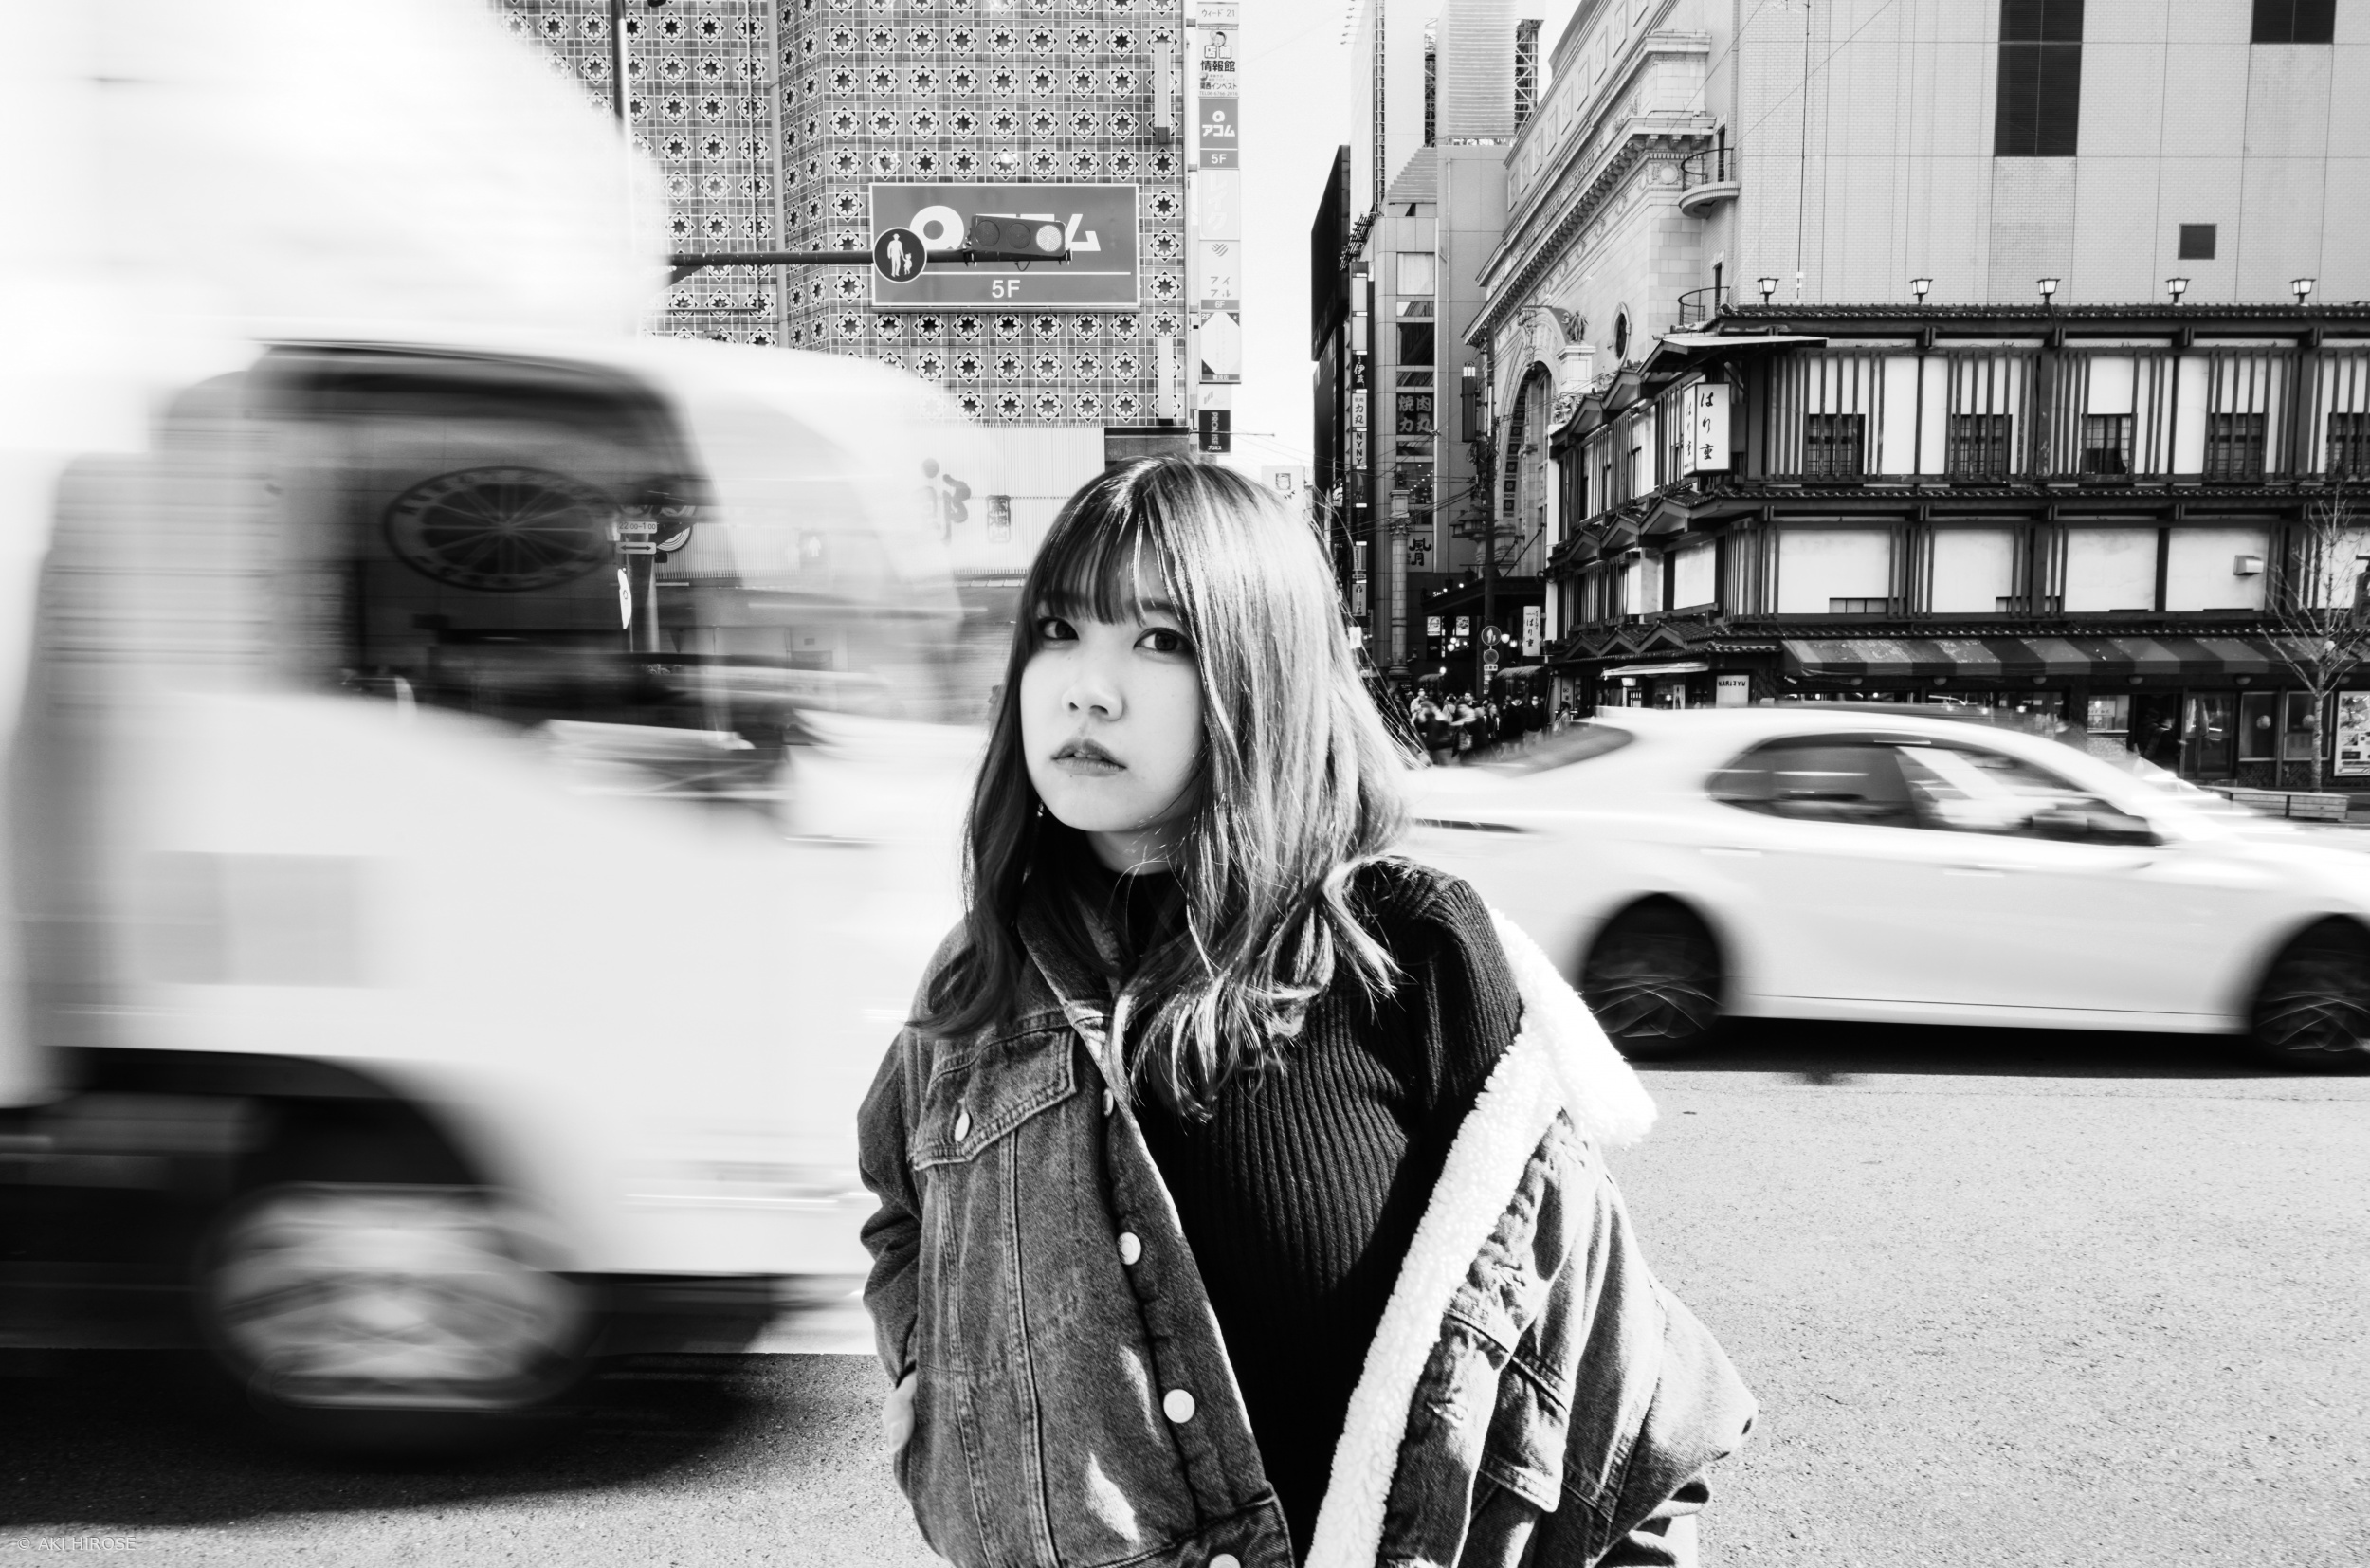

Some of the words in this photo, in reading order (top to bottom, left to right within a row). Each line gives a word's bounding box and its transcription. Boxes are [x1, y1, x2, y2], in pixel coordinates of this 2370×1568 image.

[1226, 9, 1235, 18] 21
[1199, 60, 1236, 72] 情報館
[1201, 124, 1236, 137] アコム
[1211, 154, 1227, 164] 5F
[1207, 172, 1229, 231] レイク
[992, 279, 1021, 298] 5F
[1214, 301, 1226, 309] 6F
[1398, 394, 1432, 412] 焼肉
[1355, 403, 1364, 424] 力丸
[1398, 416, 1432, 432] 力丸
[1699, 392, 1714, 460] はり重
[1408, 538, 1432, 567] 風月
